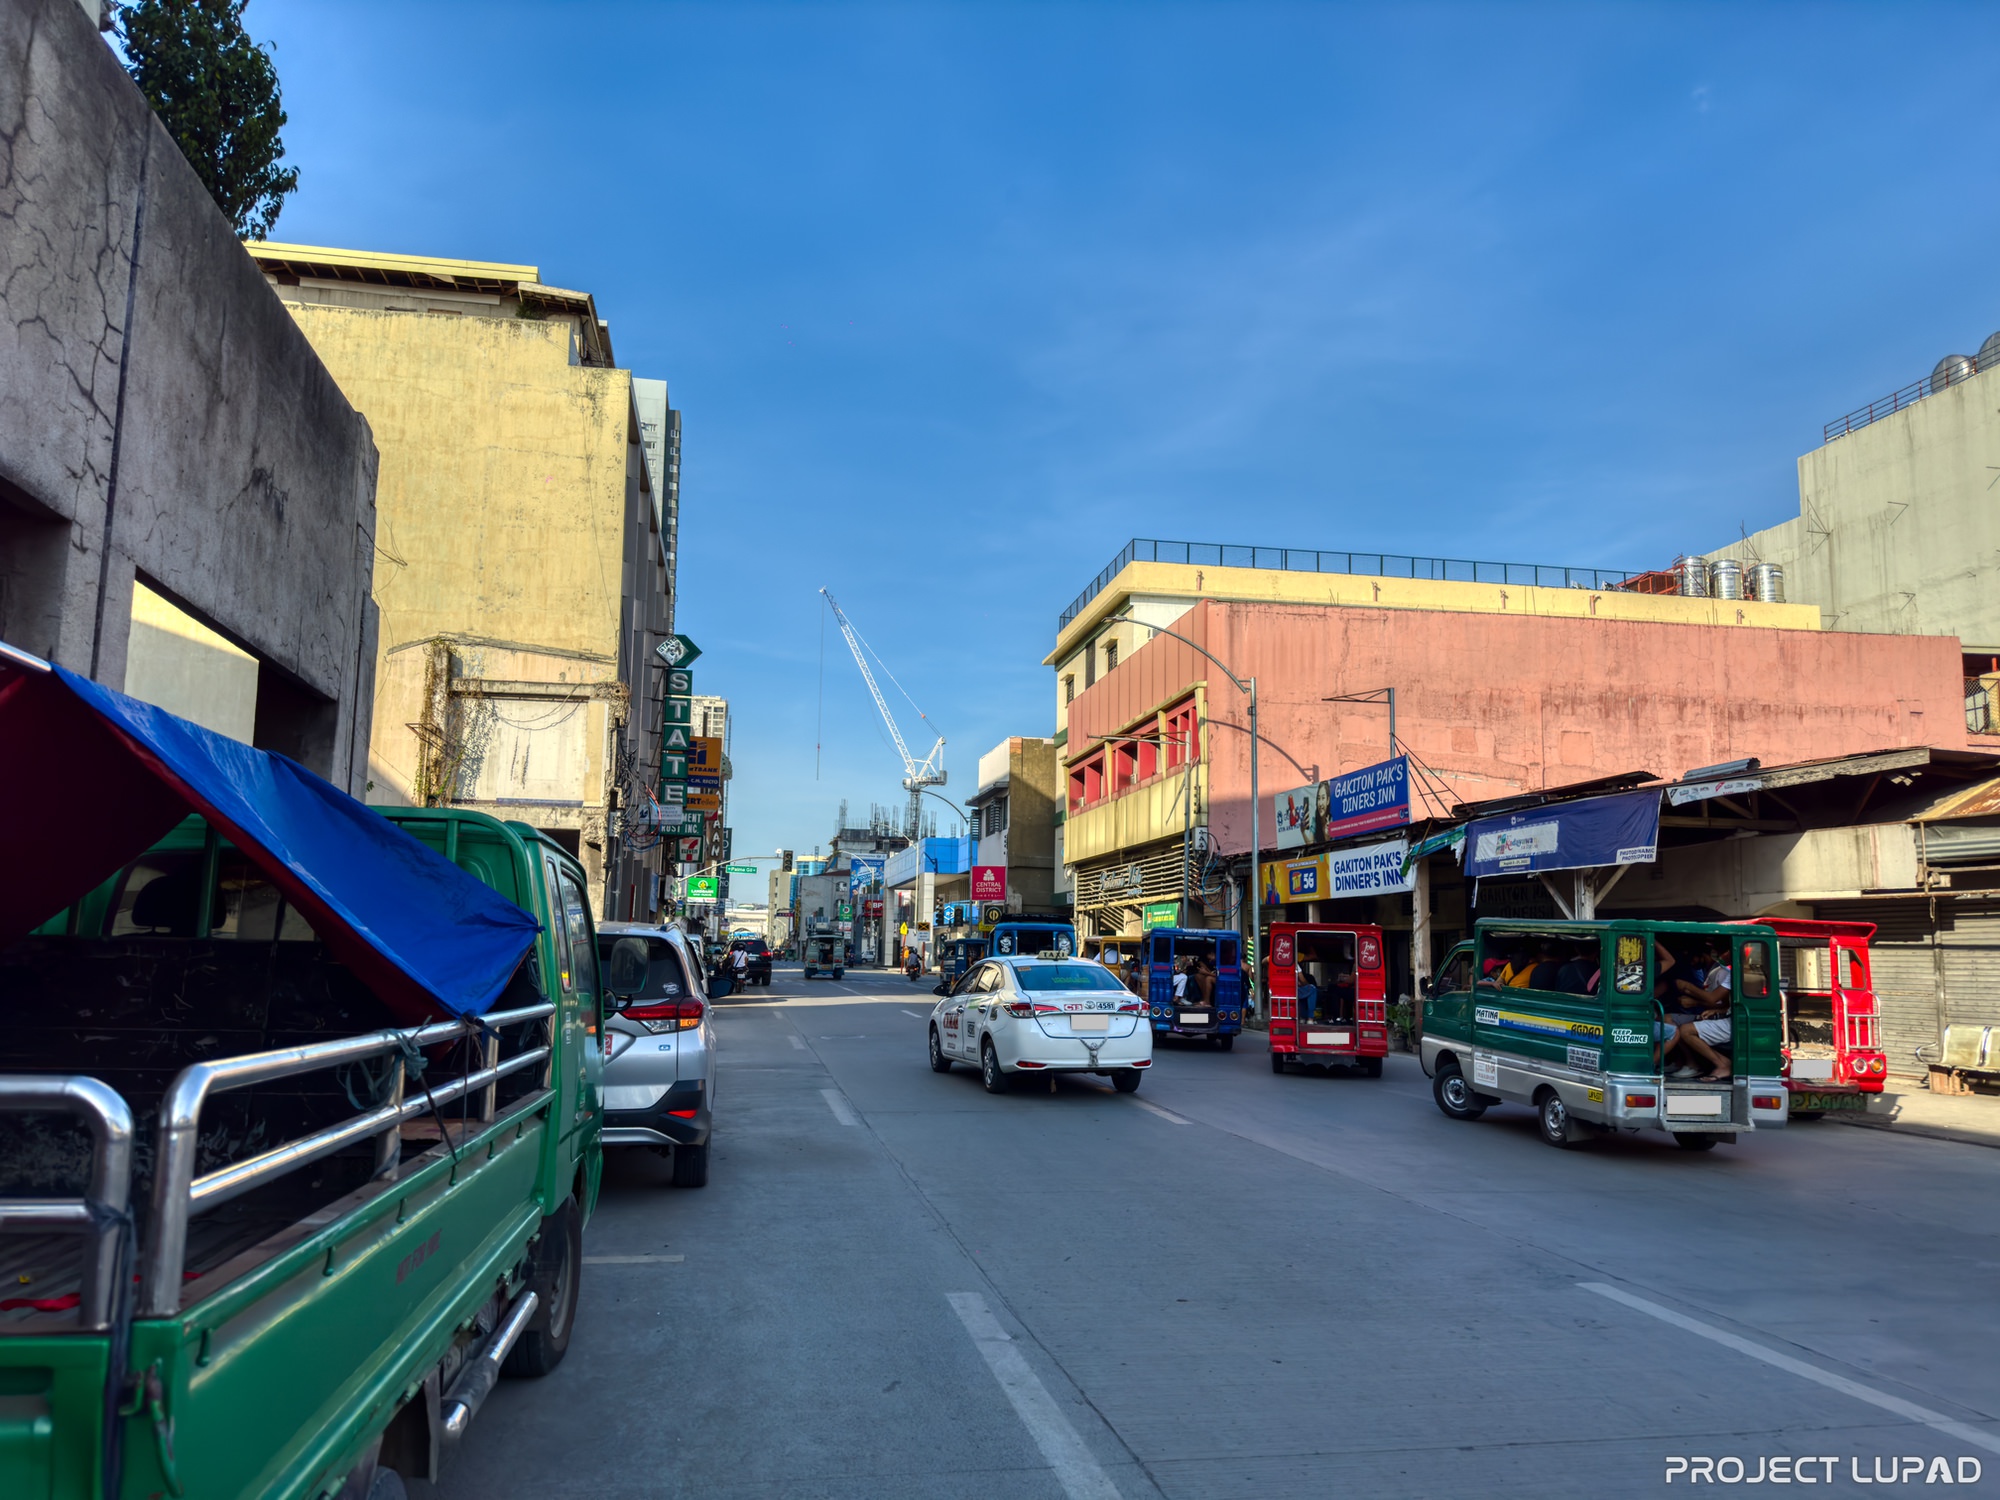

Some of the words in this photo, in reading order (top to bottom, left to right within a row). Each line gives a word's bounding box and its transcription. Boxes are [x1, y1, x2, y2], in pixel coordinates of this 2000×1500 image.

[664, 672, 689, 804] STATE
[1334, 771, 1375, 799] GAKITON
[1376, 763, 1404, 787] PAK'S
[1342, 791, 1376, 814] DINERS
[1377, 785, 1396, 806] INN
[684, 823, 700, 834] INC.
[682, 837, 699, 861] 7
[1334, 857, 1373, 875] GAKITON
[1374, 851, 1403, 869] PAK'S
[1303, 872, 1315, 889] 5G
[1335, 870, 1381, 892] DINNER'S
[1476, 1008, 1499, 1020] MATINA
[1570, 1023, 1601, 1040] AGDAO
[1614, 1034, 1647, 1043] DISTANCE
